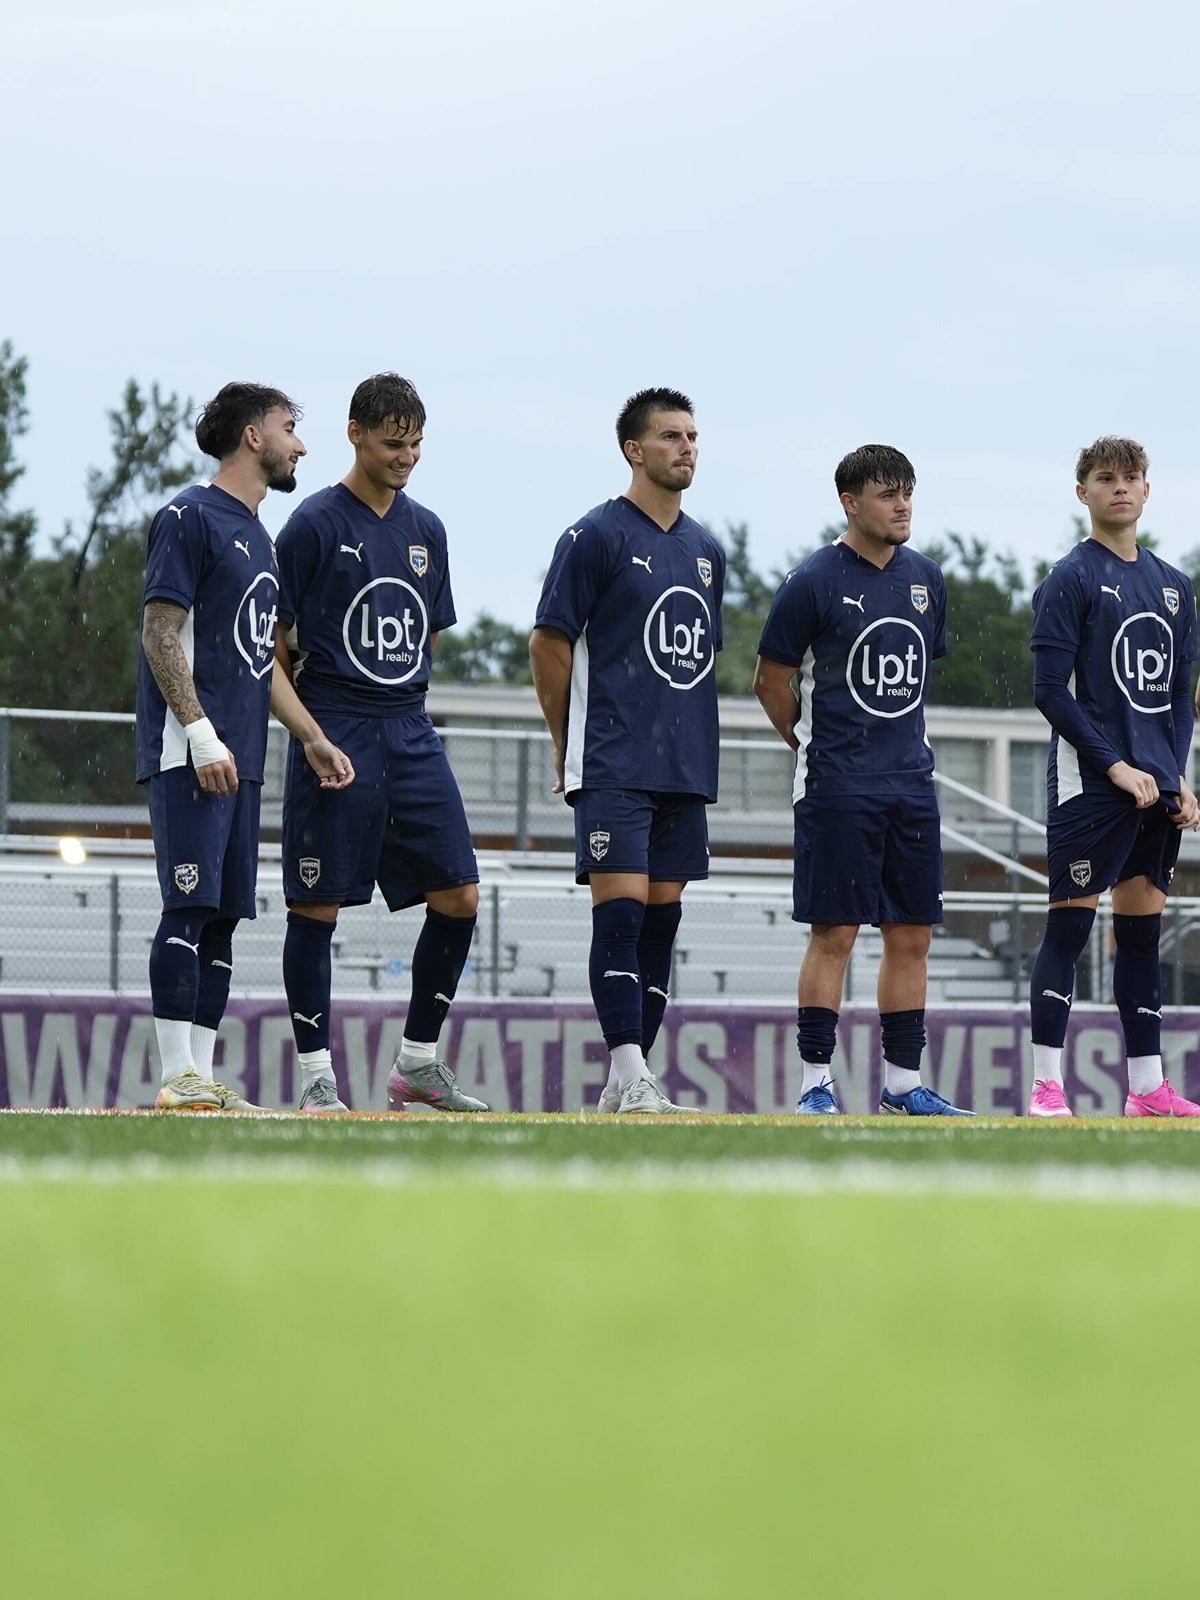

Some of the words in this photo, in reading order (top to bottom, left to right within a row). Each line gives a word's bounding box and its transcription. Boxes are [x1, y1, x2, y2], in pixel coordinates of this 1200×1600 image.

[361, 603, 415, 661] lpt
[659, 611, 706, 665] lpt
[386, 652, 412, 665] realty
[678, 659, 697, 672] realty
[862, 644, 919, 696] lpt
[887, 687, 912, 698] realty
